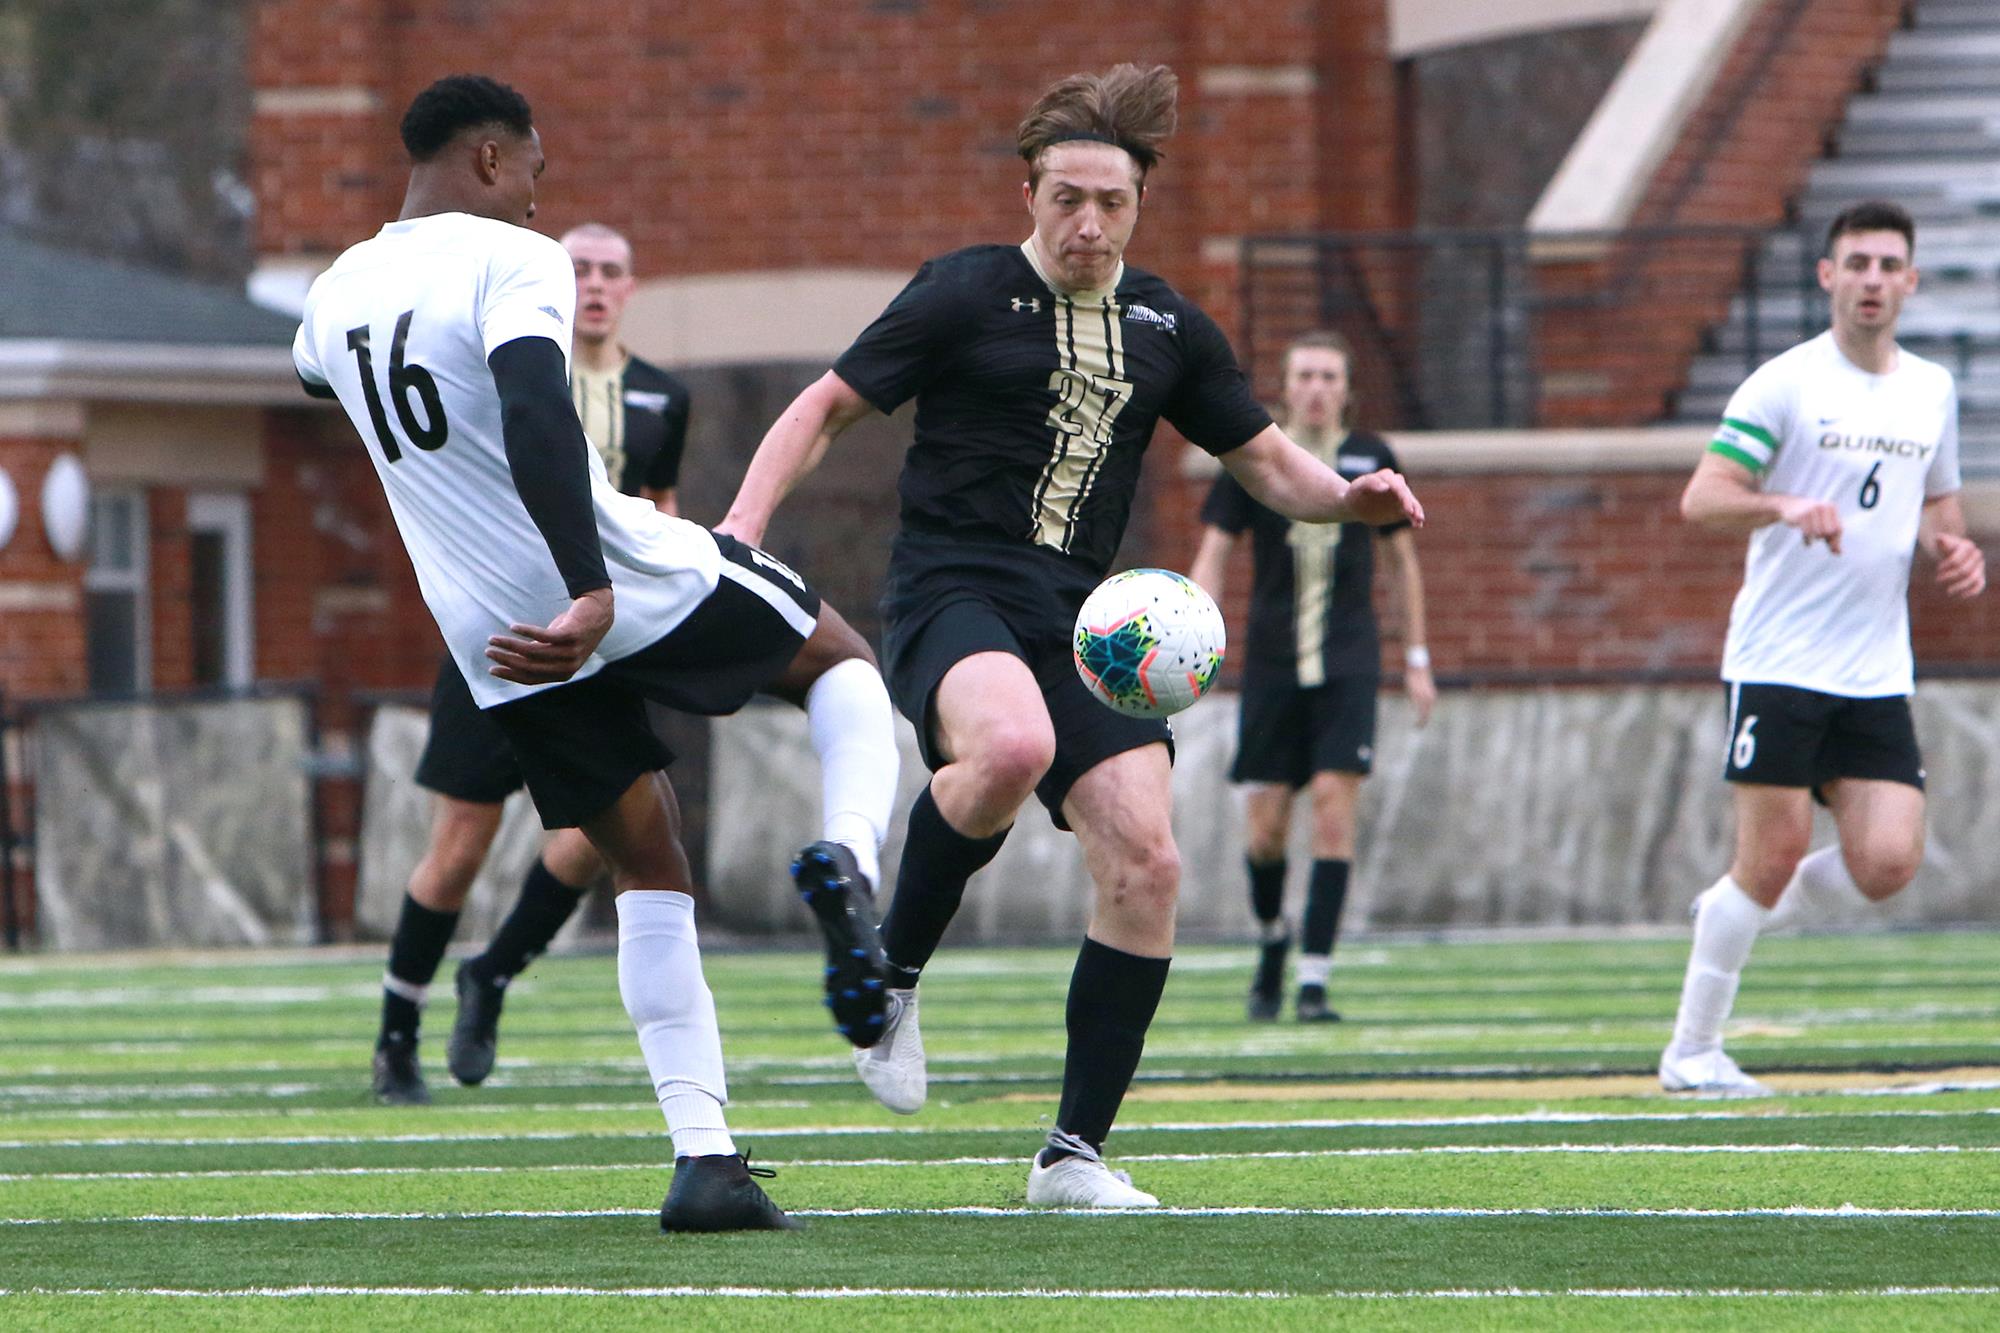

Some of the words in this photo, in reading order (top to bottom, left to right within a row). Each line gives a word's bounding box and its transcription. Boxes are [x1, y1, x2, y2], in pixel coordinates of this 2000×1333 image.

[1126, 304, 1176, 329] LINDENOD
[346, 309, 449, 464] 16
[1045, 368, 1134, 445] 27
[1818, 432, 1932, 459] QUINCY
[1859, 460, 1882, 509] 6
[1733, 715, 1759, 769] 6
